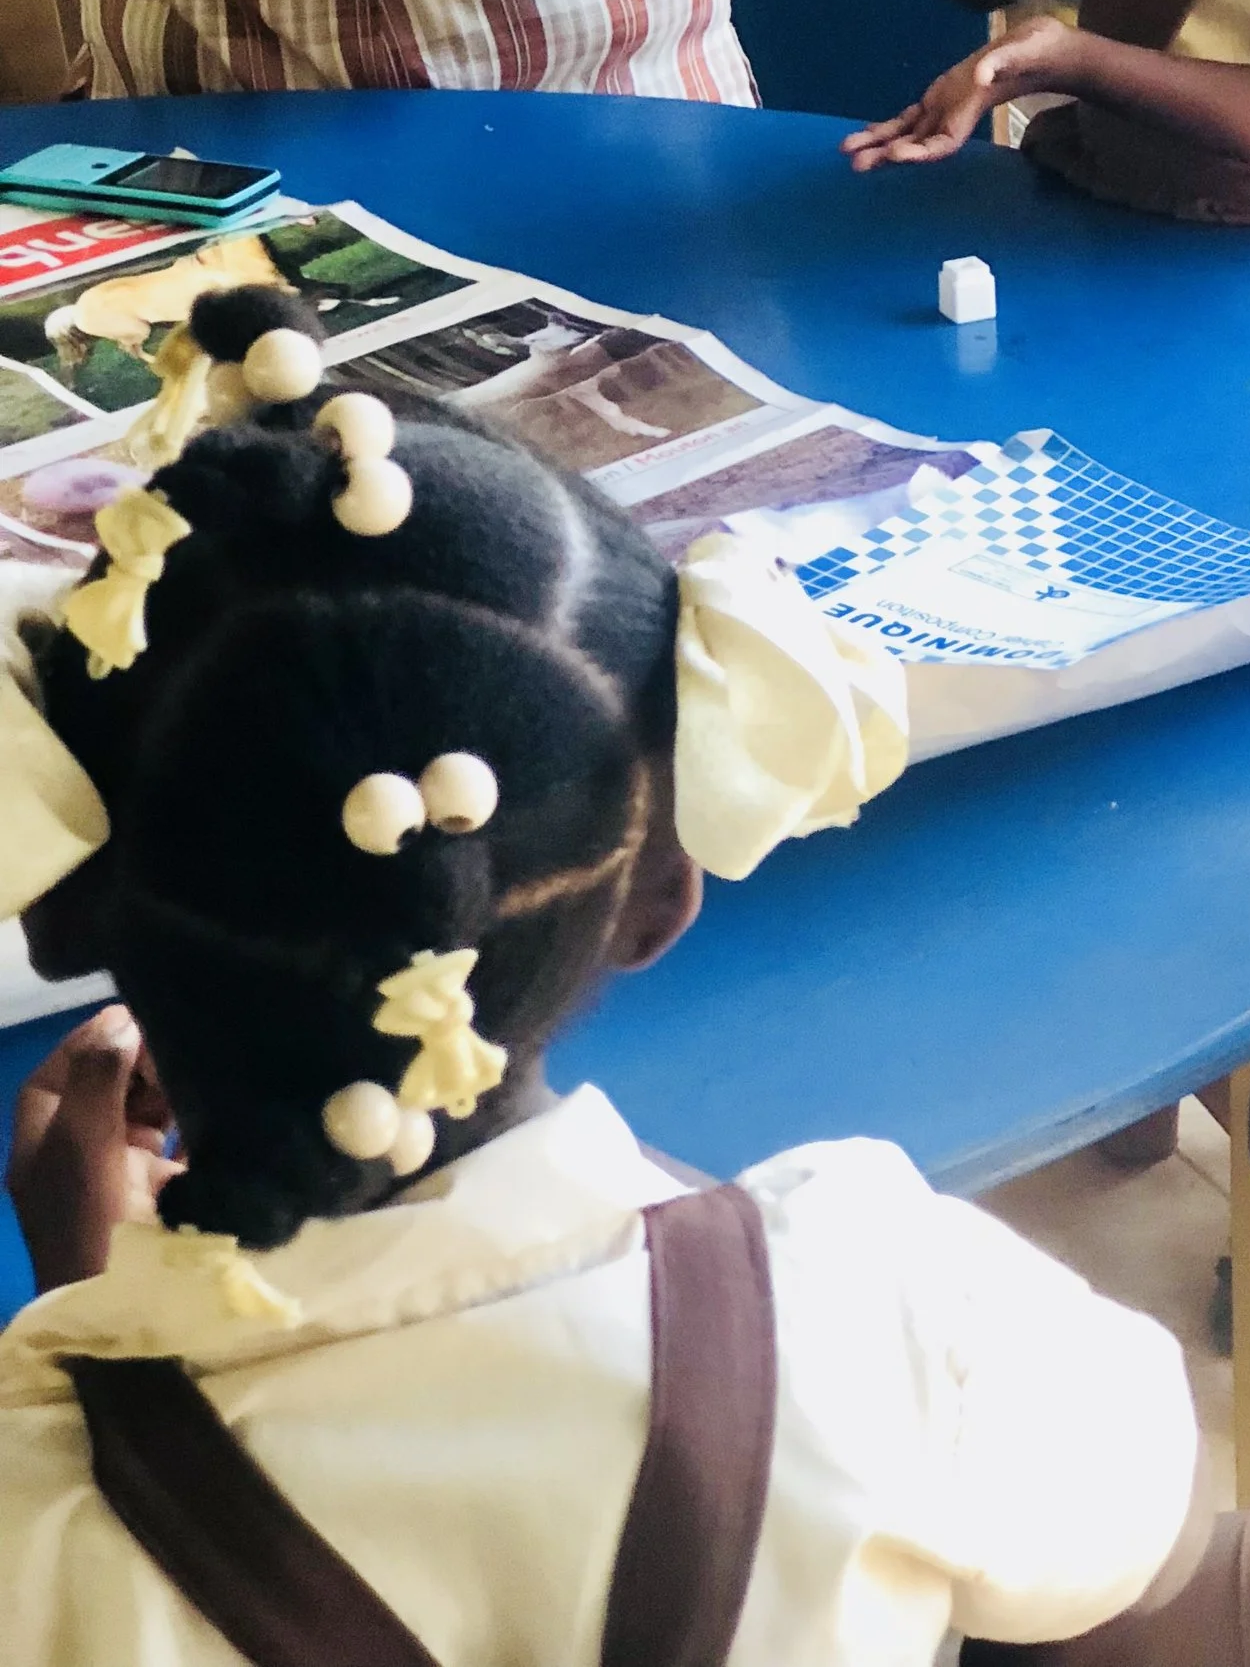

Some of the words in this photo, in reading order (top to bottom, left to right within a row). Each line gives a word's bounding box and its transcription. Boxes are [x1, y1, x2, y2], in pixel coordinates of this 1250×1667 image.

[0, 219, 167, 269] que
[822, 602, 1062, 659] DOMINIQUE
[876, 598, 996, 641] Composition
